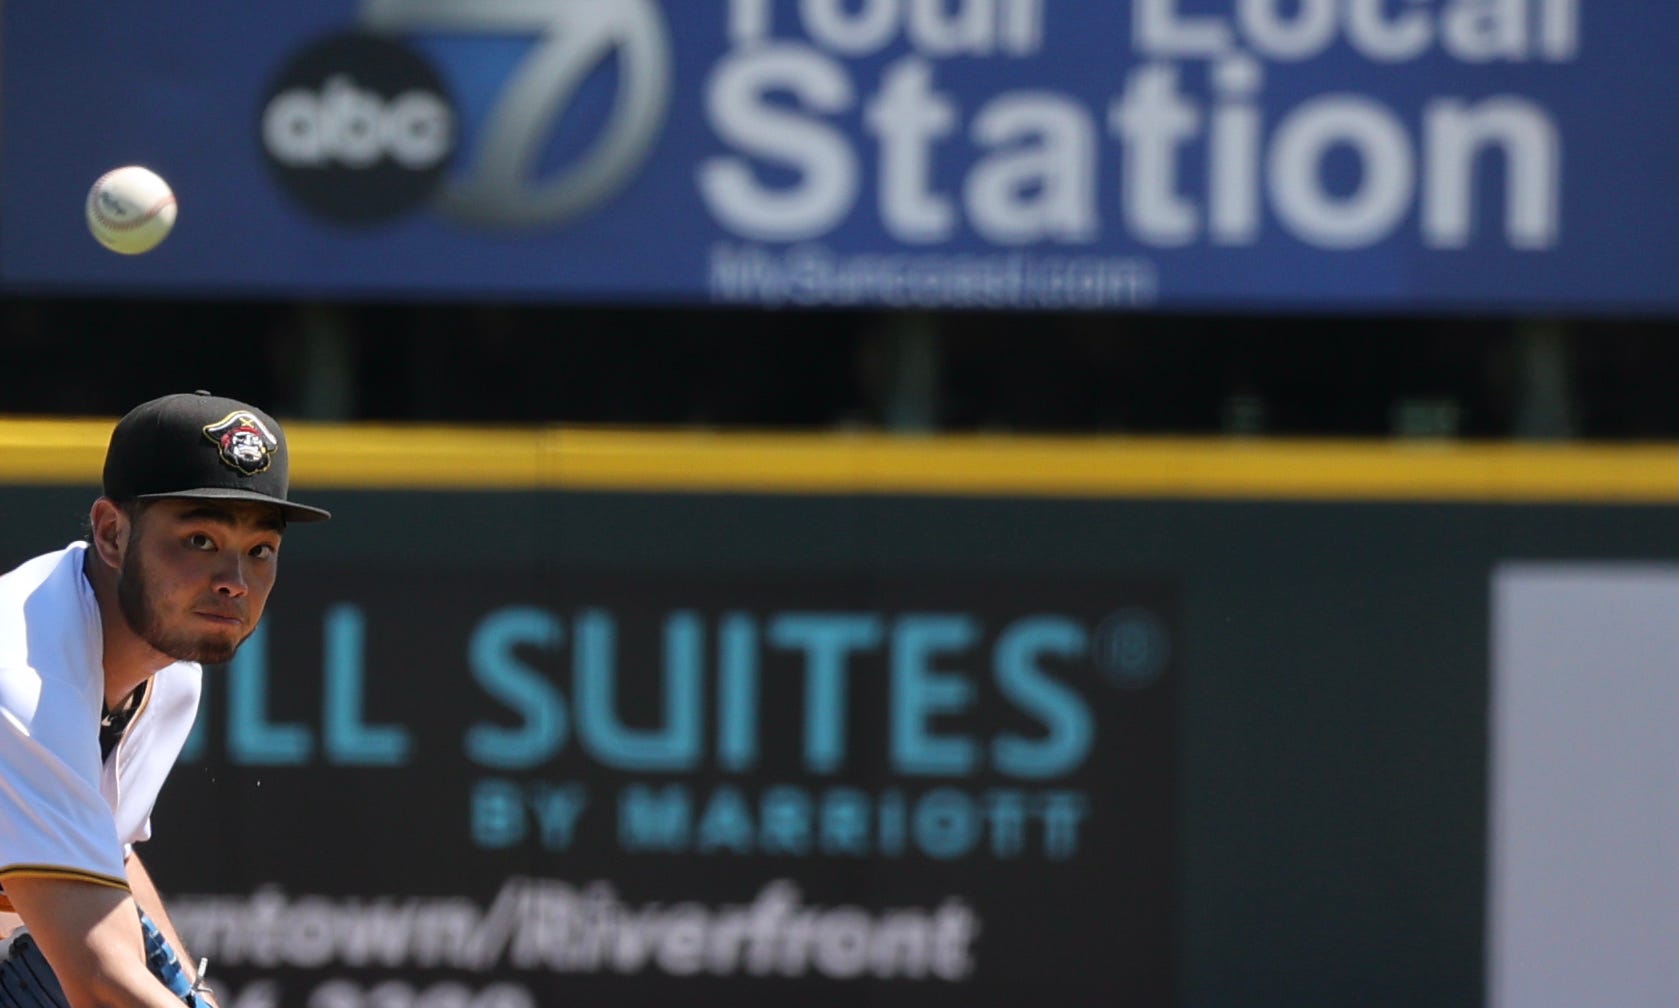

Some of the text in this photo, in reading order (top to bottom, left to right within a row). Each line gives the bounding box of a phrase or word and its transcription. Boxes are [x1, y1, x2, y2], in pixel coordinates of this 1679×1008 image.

[262, 76, 452, 169] abc
[698, 42, 1560, 250] Station
[464, 606, 1096, 778] SUITES
[470, 778, 1090, 860] BY MARRIOTT
[168, 876, 980, 980] ntown/Riverfront
